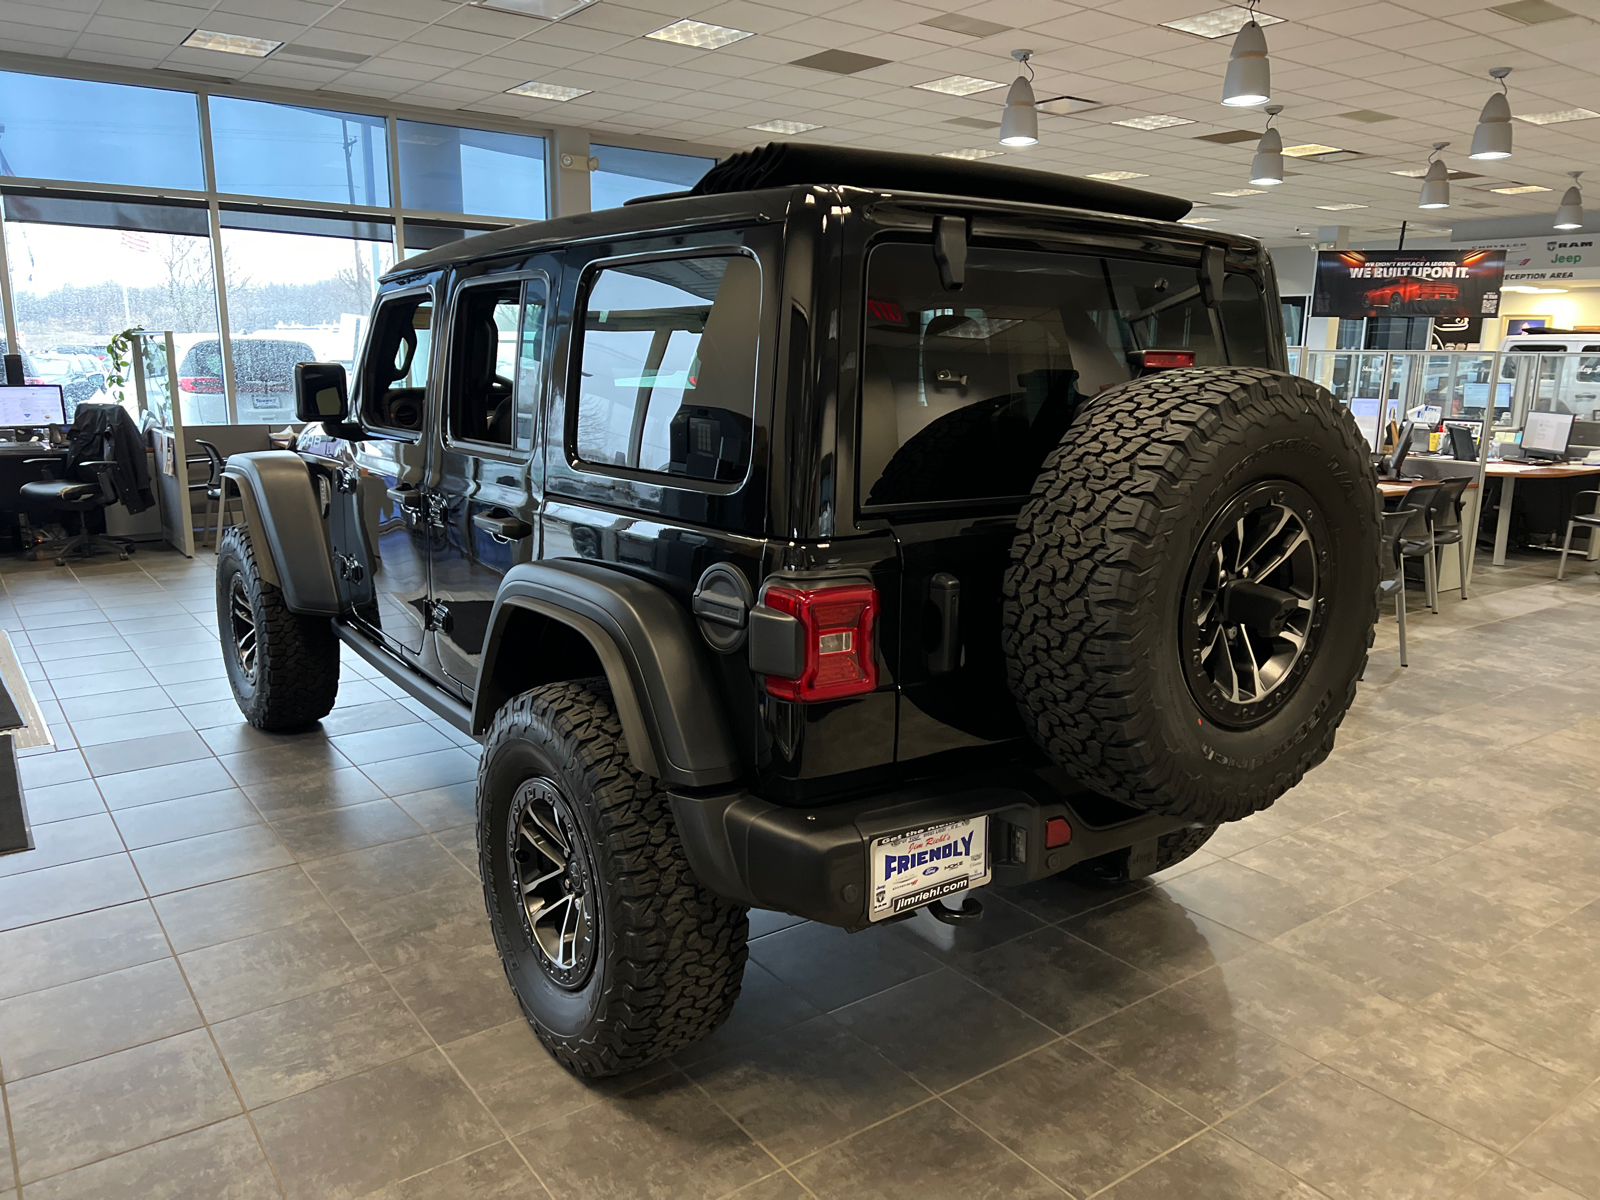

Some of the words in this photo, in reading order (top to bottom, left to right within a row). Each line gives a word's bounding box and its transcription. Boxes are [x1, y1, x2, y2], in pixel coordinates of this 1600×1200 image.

[1551, 254, 1582, 264] Jeep
[1350, 267, 1371, 278] WE
[1374, 267, 1410, 278] BUILT
[1412, 266, 1453, 278] UPON
[1455, 267, 1470, 278] IT.
[1503, 272, 1547, 280] ECEPTION
[908, 842, 923, 853] Jim
[885, 830, 974, 881] FRIENDLY
